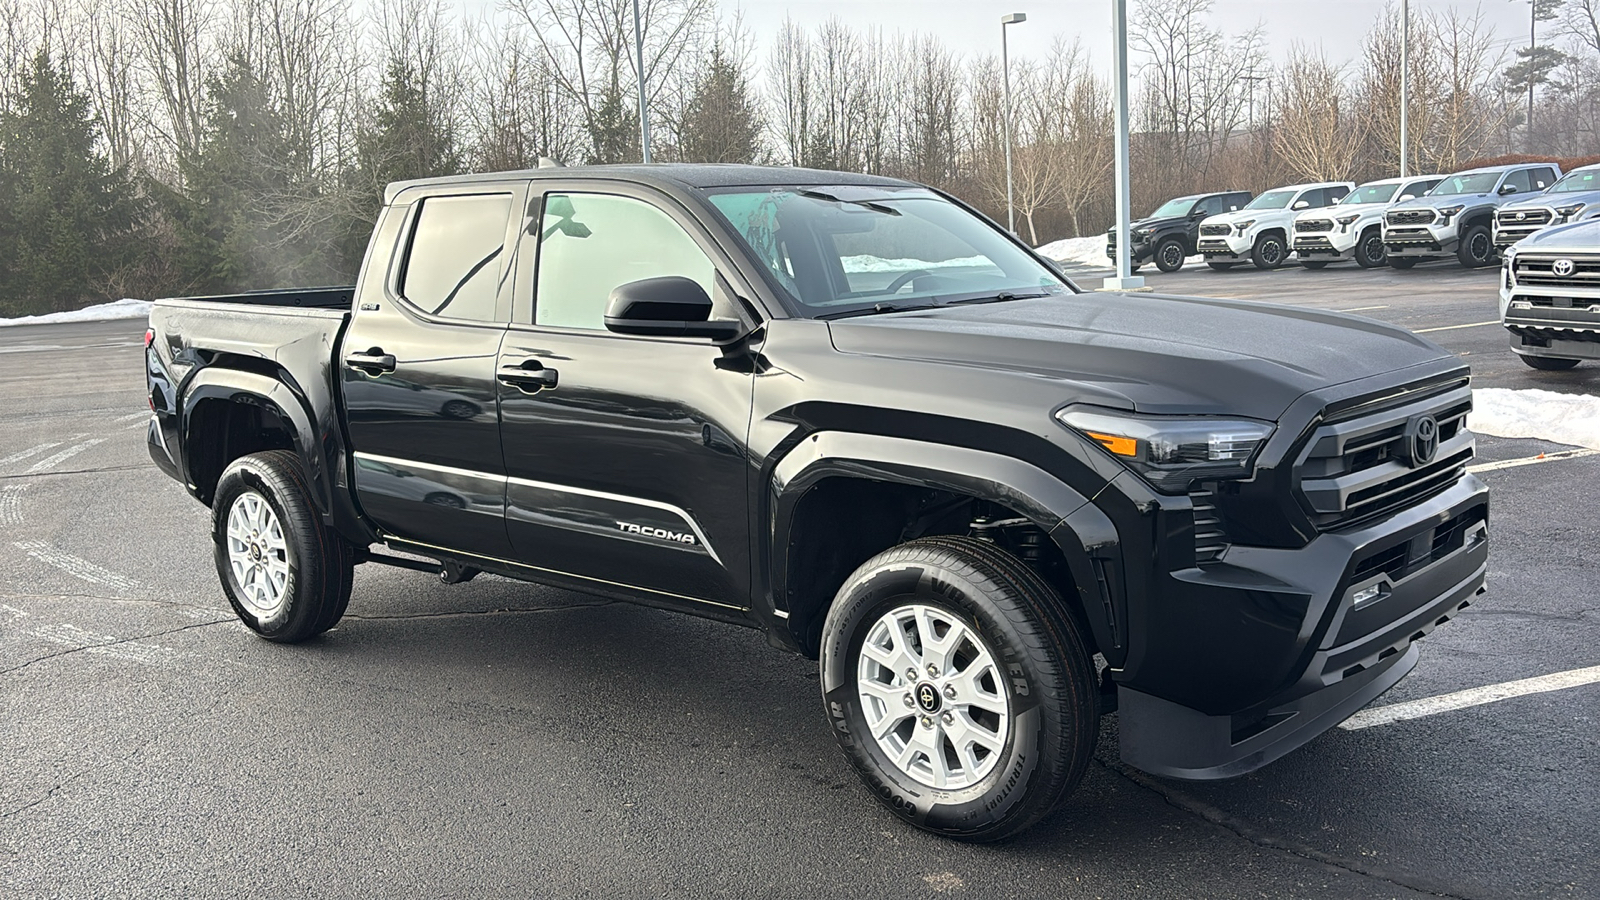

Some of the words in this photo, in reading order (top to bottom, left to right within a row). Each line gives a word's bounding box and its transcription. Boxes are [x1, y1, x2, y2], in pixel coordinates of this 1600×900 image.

[615, 520, 696, 545] TACOMA
[830, 700, 918, 818] GOODEAR
[984, 752, 1027, 813] TERRITORY
